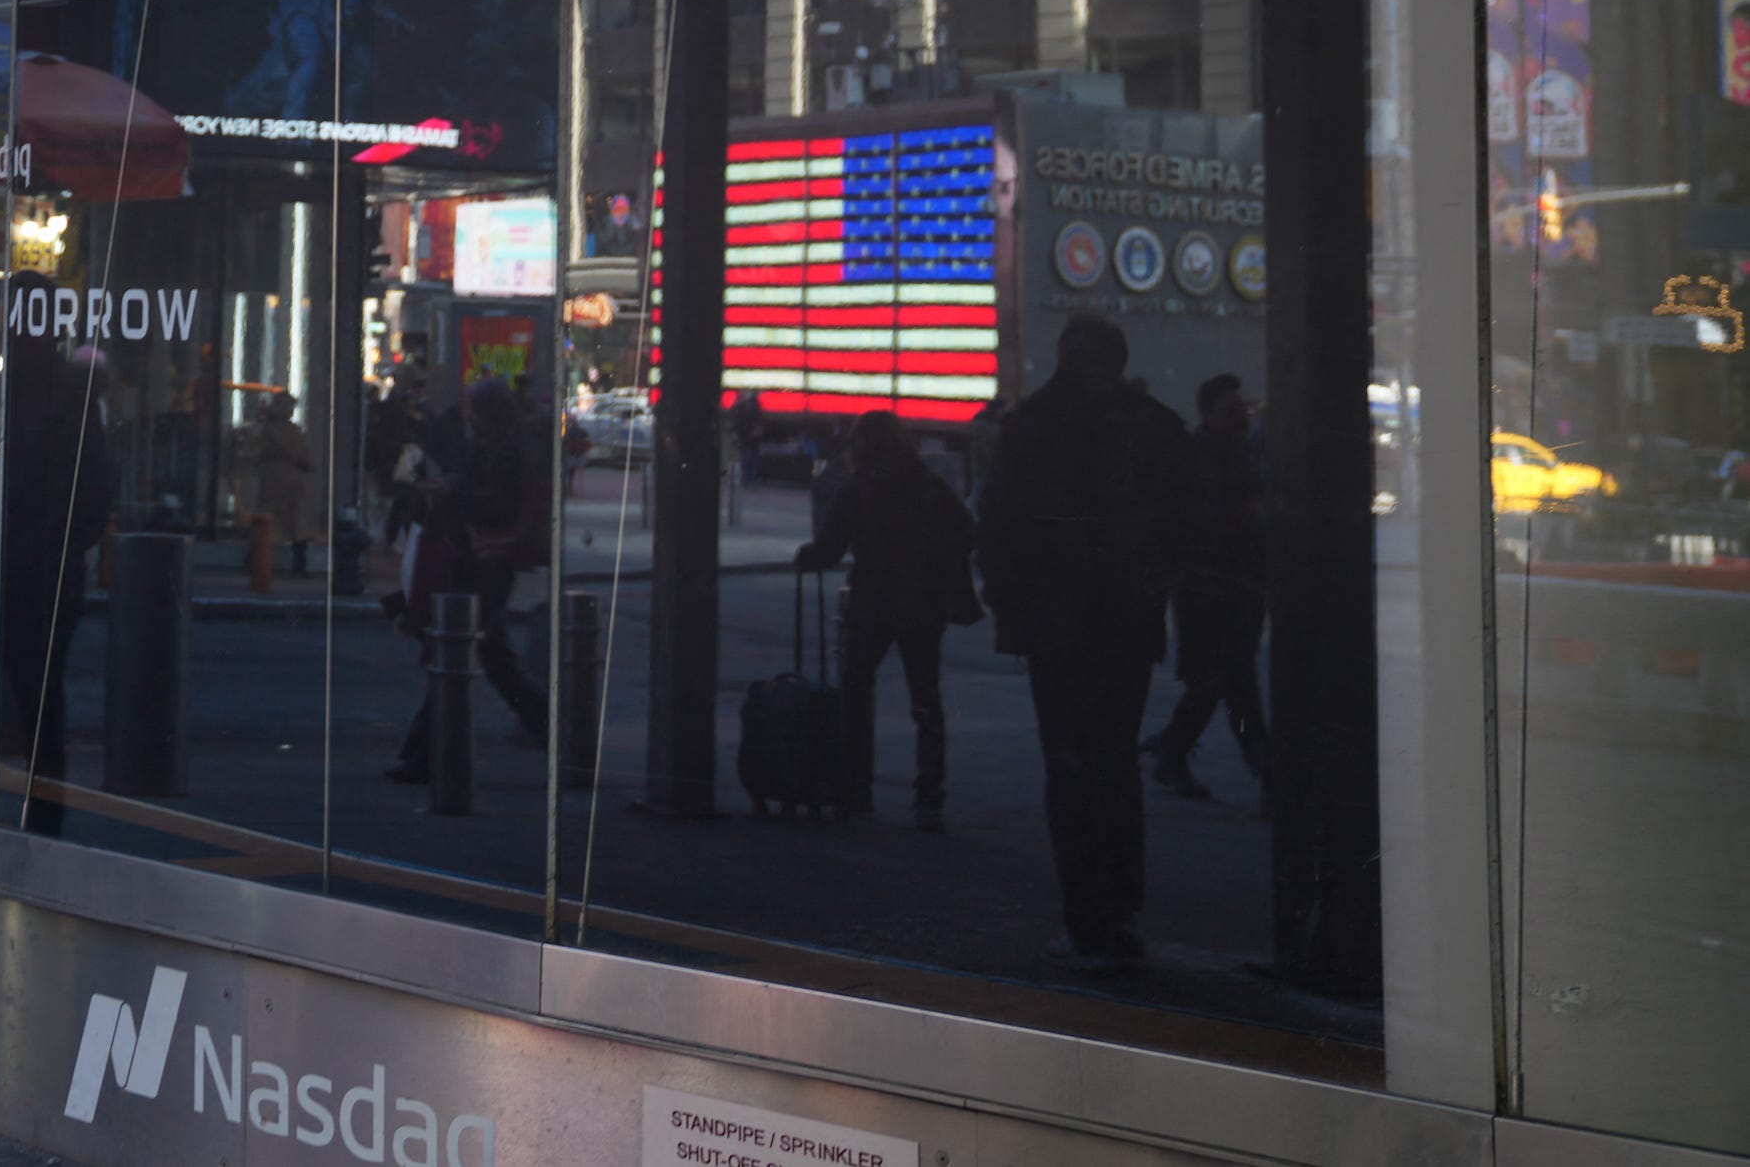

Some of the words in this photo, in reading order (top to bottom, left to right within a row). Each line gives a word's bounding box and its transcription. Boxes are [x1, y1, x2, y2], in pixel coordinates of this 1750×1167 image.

[193, 1024, 498, 1167] Nasdaq
[671, 1110, 765, 1147] STANDPIPE
[779, 1134, 883, 1167] SPRINKLER
